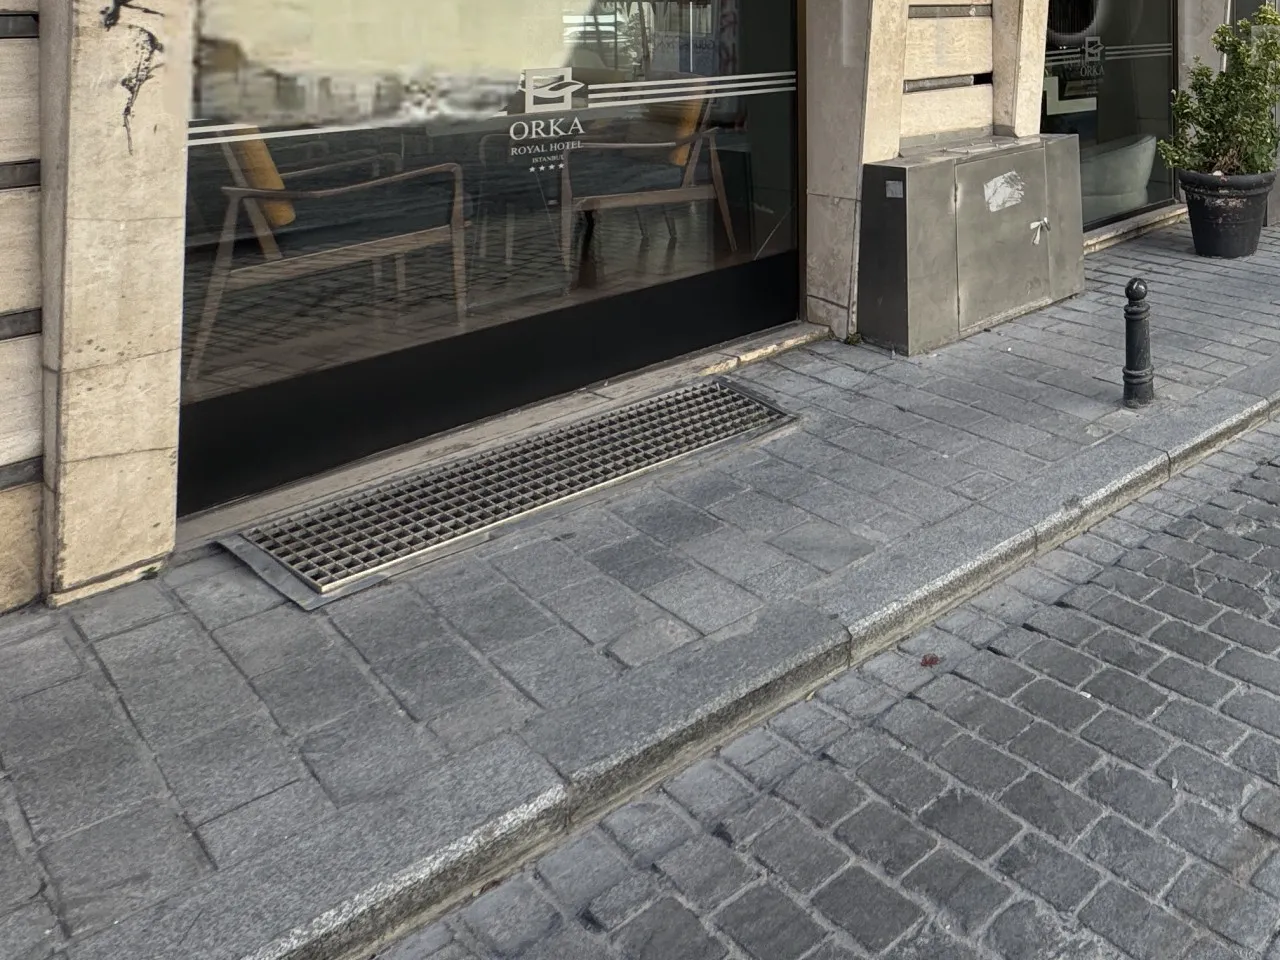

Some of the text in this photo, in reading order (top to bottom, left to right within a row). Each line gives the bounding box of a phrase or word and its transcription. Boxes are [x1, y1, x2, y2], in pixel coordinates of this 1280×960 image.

[1080, 65, 1105, 77] ORKA
[509, 117, 585, 140] ORKA
[511, 140, 584, 156] ROYAL HOTEL
